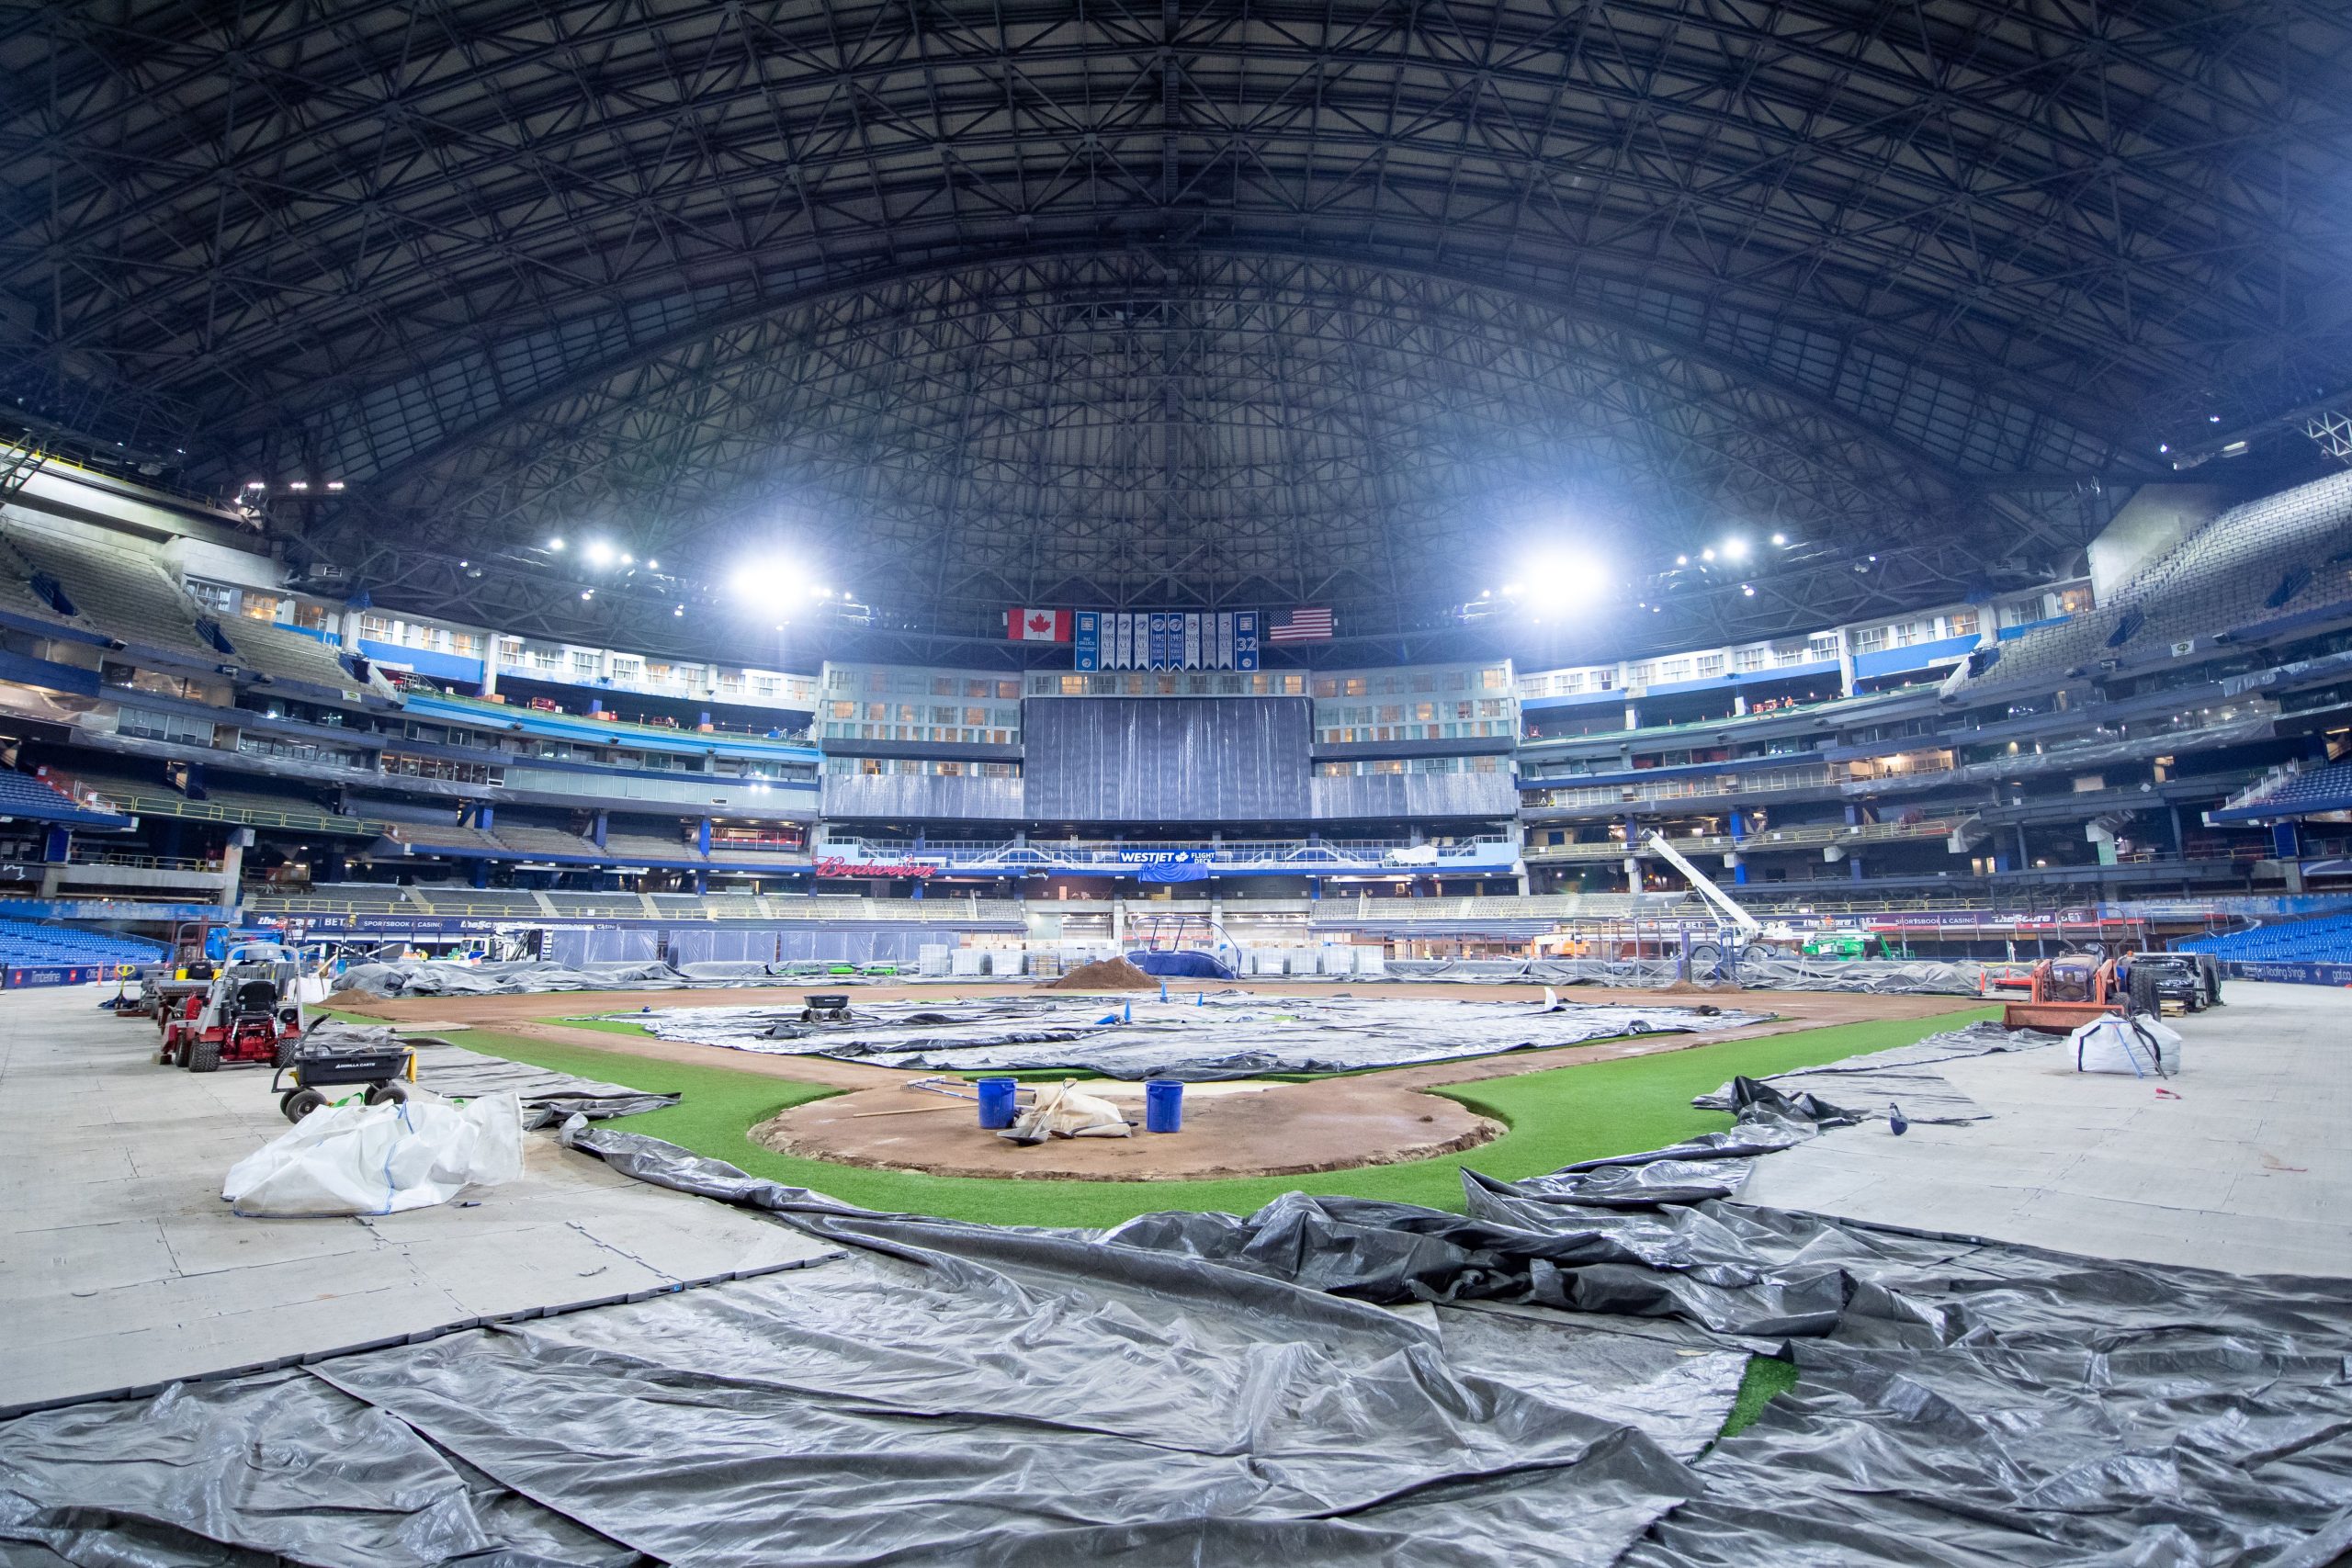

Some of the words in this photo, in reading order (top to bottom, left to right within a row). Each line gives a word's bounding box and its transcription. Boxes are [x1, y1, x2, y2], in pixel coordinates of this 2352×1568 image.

[1237, 637, 1257, 652] 32
[1121, 852, 1174, 864] WESTJET
[812, 856, 937, 877] Budweiser
[32, 970, 60, 983] Timberline
[2267, 966, 2287, 980] Roofing
